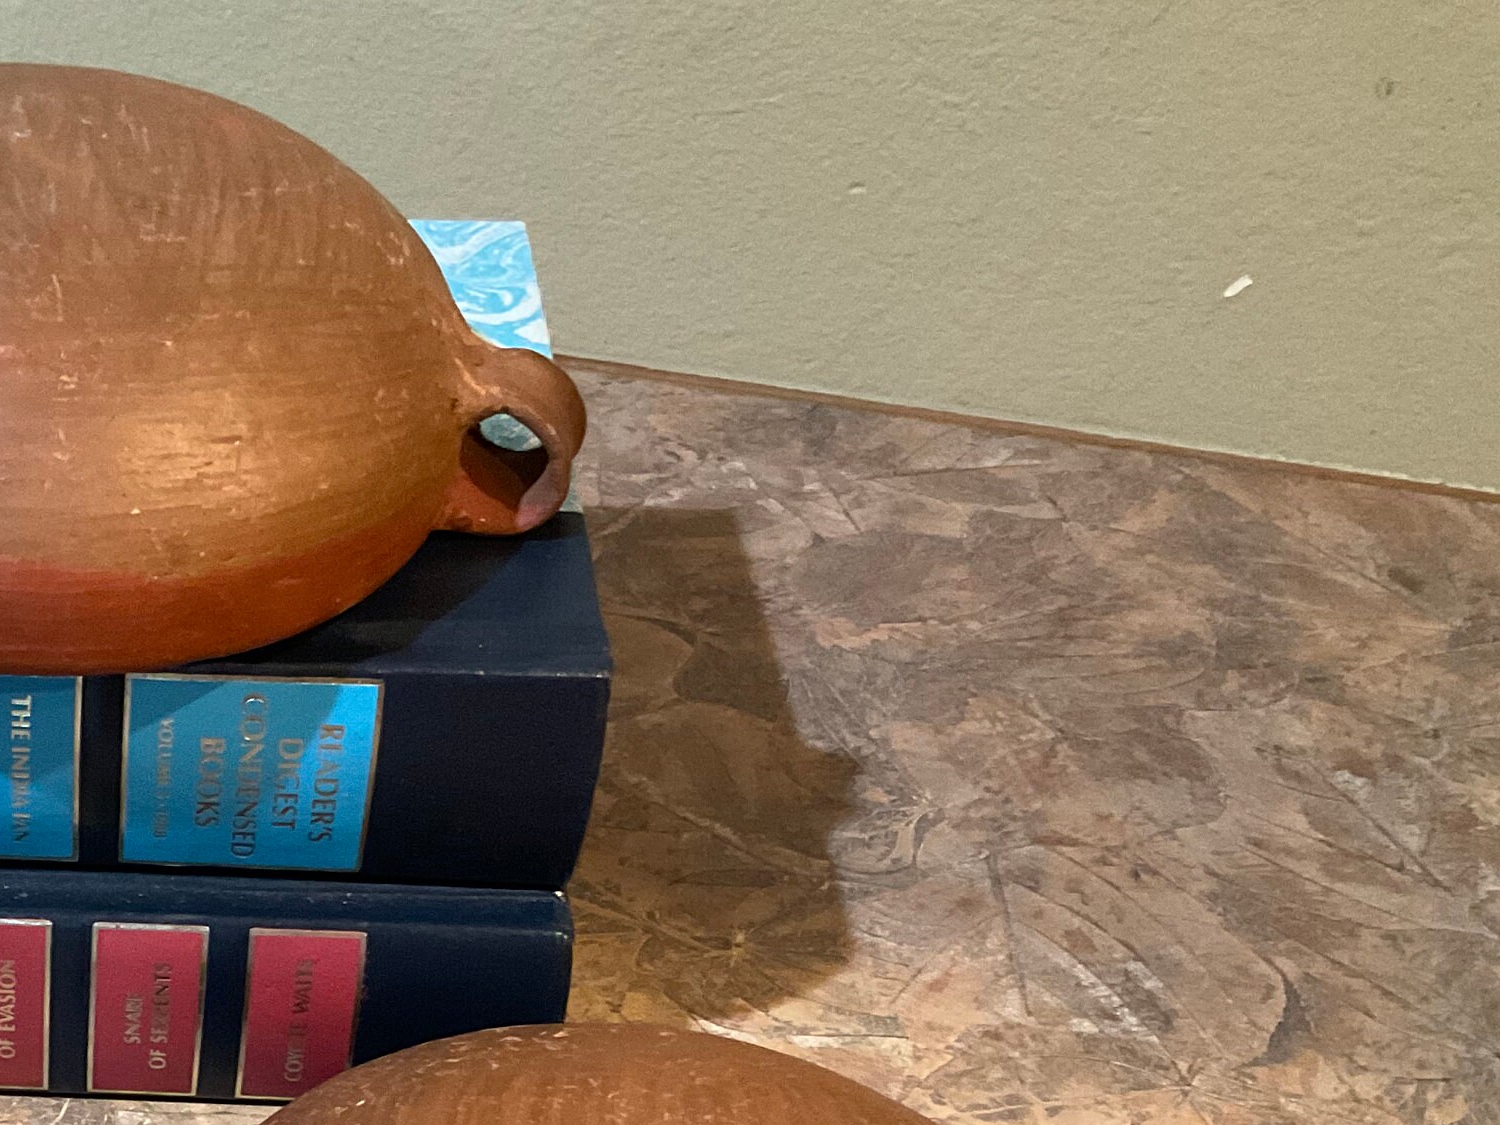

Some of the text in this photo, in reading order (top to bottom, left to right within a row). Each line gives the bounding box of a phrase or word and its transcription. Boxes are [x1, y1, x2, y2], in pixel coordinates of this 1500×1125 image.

[11, 694, 32, 740] THE
[194, 737, 227, 828] BOOKS
[230, 693, 268, 859] CONDENSED
[271, 738, 304, 830] DIGEST
[308, 723, 346, 842] READER'S
[148, 1049, 167, 1070] OF
